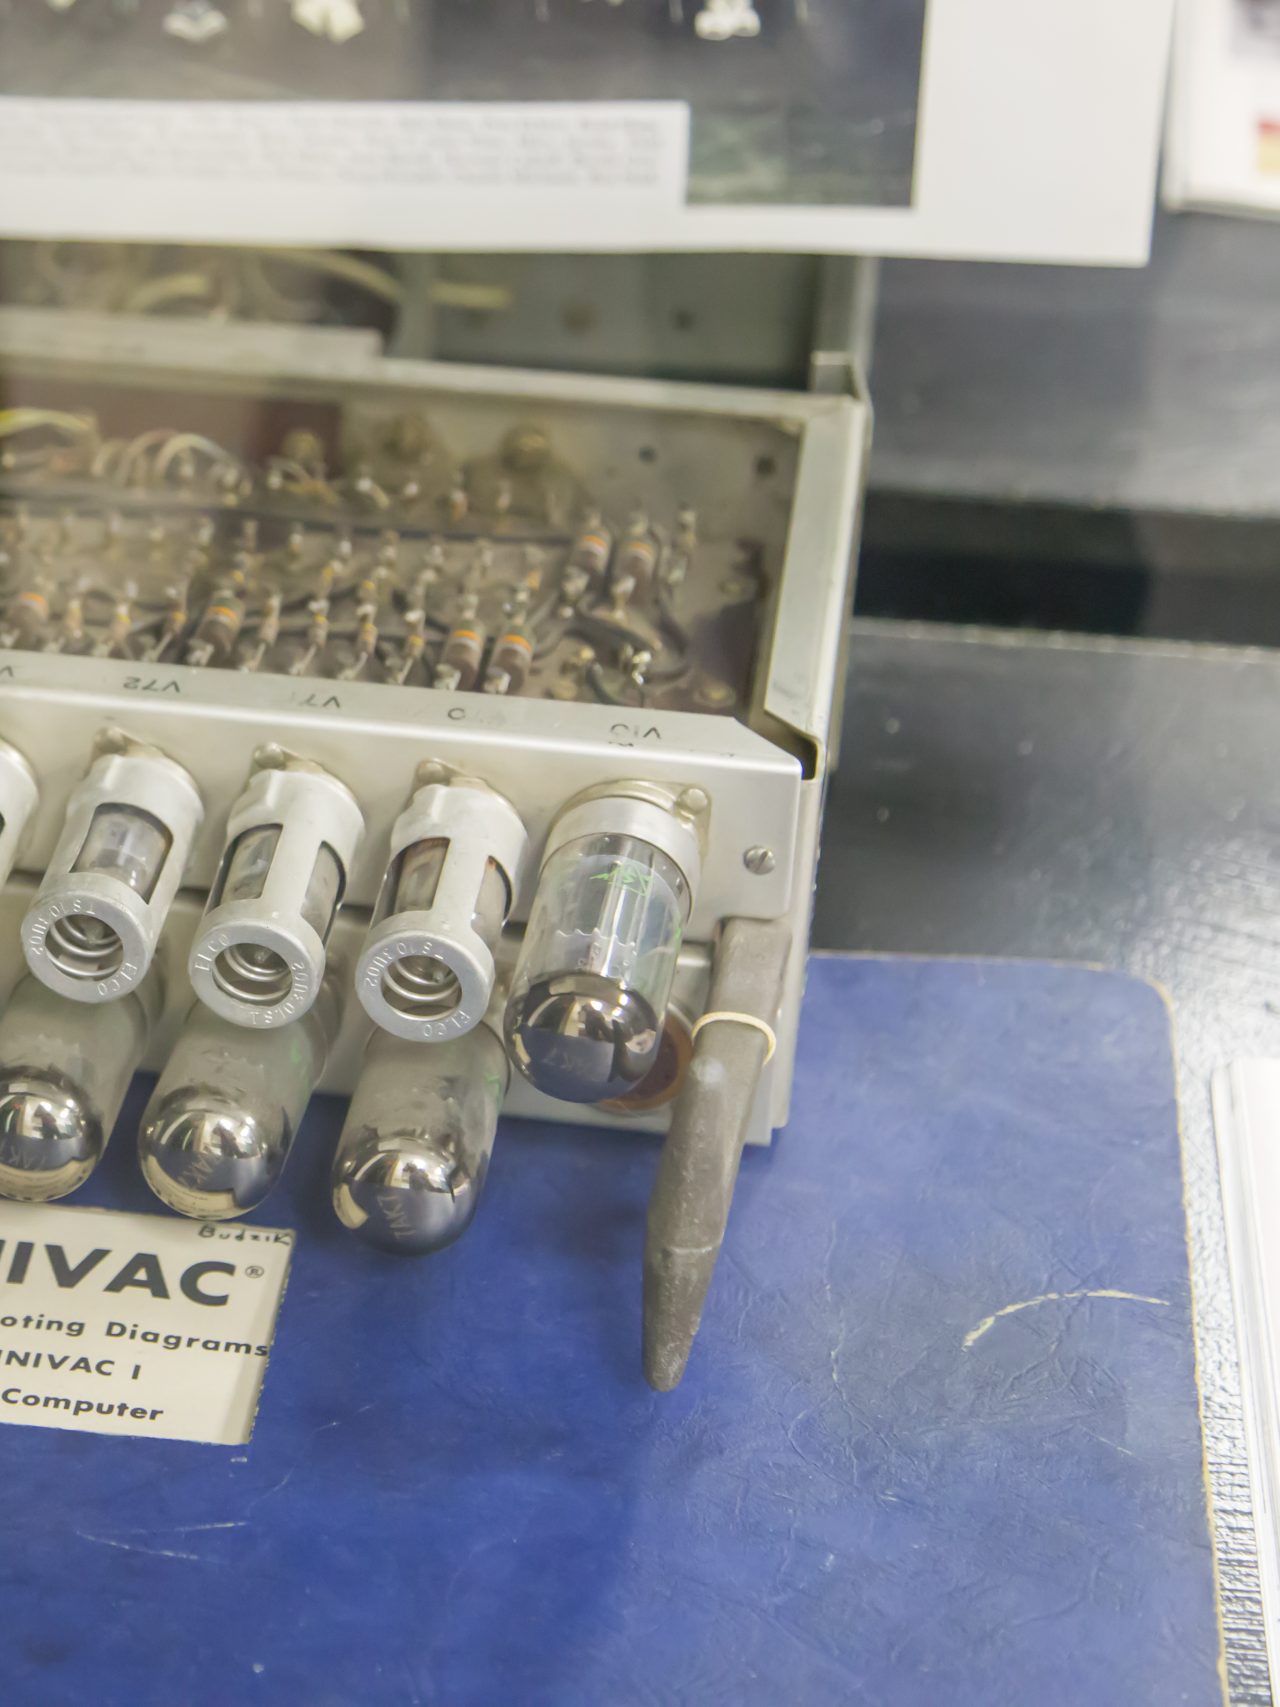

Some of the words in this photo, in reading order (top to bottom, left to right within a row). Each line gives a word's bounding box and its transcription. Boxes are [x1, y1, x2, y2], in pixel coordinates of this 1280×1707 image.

[123, 675, 181, 694] V72
[194, 934, 231, 972] ELCO
[97, 962, 138, 996] ELCO
[422, 1009, 471, 1037] ELCO
[105, 1321, 268, 1357] Diagrams
[131, 1364, 141, 1380] I
[1, 1387, 164, 1421] Computer
